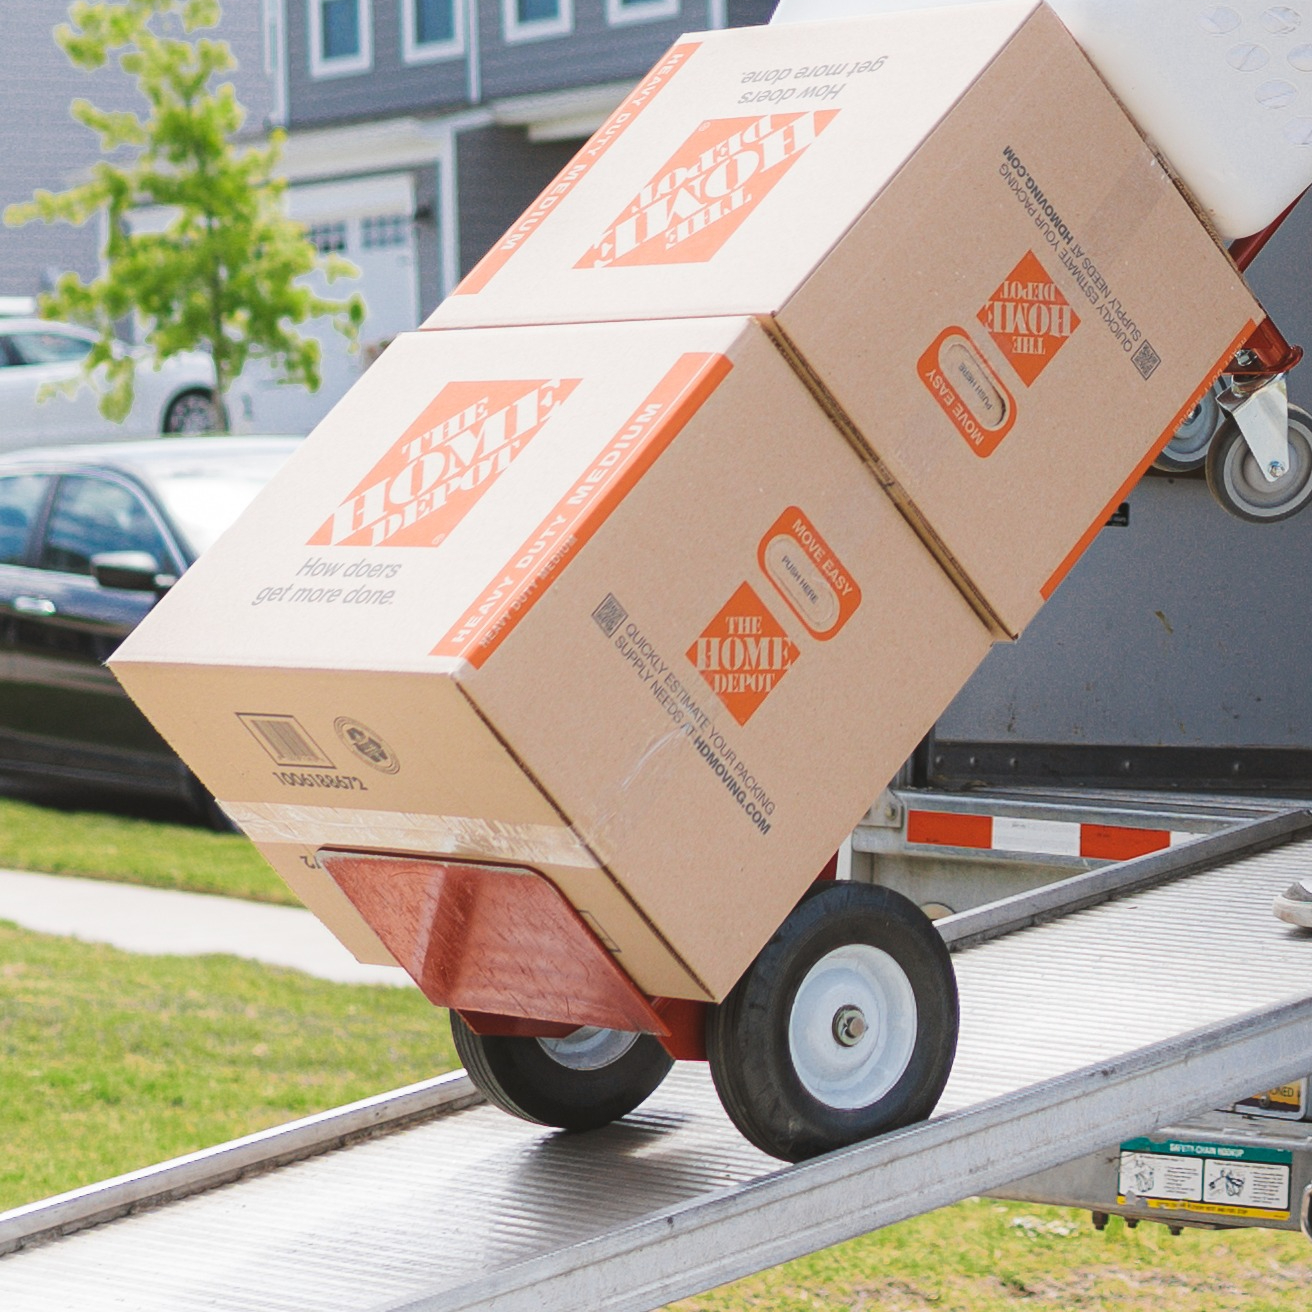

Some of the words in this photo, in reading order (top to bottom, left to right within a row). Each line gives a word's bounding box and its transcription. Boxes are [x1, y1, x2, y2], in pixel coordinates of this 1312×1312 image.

[631, 53, 684, 106] HEAVY
[740, 67, 793, 85] done.
[793, 62, 849, 80] more
[846, 55, 889, 78] get
[737, 87, 797, 105] doers
[795, 83, 847, 101] How
[588, 112, 632, 157] DUTY
[631, 114, 773, 212] DEPOT
[500, 164, 587, 251] MEDIUM
[594, 108, 818, 268] HOME
[999, 162, 1036, 218] PACKING
[1002, 145, 1075, 246] HDMOVING.COM
[665, 185, 752, 251] THE
[1034, 211, 1060, 252] YOUR
[1070, 242, 1087, 259] AT
[1000, 280, 1057, 301] DEPOT
[1058, 247, 1100, 305] ESTIMATE
[1082, 257, 1112, 296] NEEDS
[984, 300, 1072, 337] HOME
[1098, 305, 1133, 353] QUICKLY
[1107, 296, 1143, 343] SUPPLY
[1011, 336, 1046, 355] THE
[925, 368, 956, 406] EASY
[402, 396, 489, 463] THE
[952, 403, 985, 446] MOVE
[330, 378, 563, 546] HOME
[371, 440, 520, 547] DEPOT
[451, 575, 514, 643] HEAVY
[515, 515, 567, 569] DUTY
[568, 402, 663, 506] MEDIUM
[295, 556, 345, 577] How
[342, 558, 402, 579] doers
[781, 554, 801, 582] PUSH
[792, 518, 826, 563] MOVE
[821, 559, 853, 596] EASY
[251, 583, 294, 606] get
[288, 587, 343, 604] more
[342, 584, 396, 605] done.
[725, 616, 763, 635] THE
[696, 637, 794, 672] HOME
[713, 672, 776, 693] DEPOT
[614, 636, 653, 684] SUPPLY
[650, 681, 683, 725] NEEDS
[693, 735, 772, 836] HDMOVING.COM
[625, 623, 668, 673] QUICKLY
[663, 674, 711, 731] ESTIMATE
[708, 725, 737, 766] YOUR
[734, 760, 776, 816] PACKING
